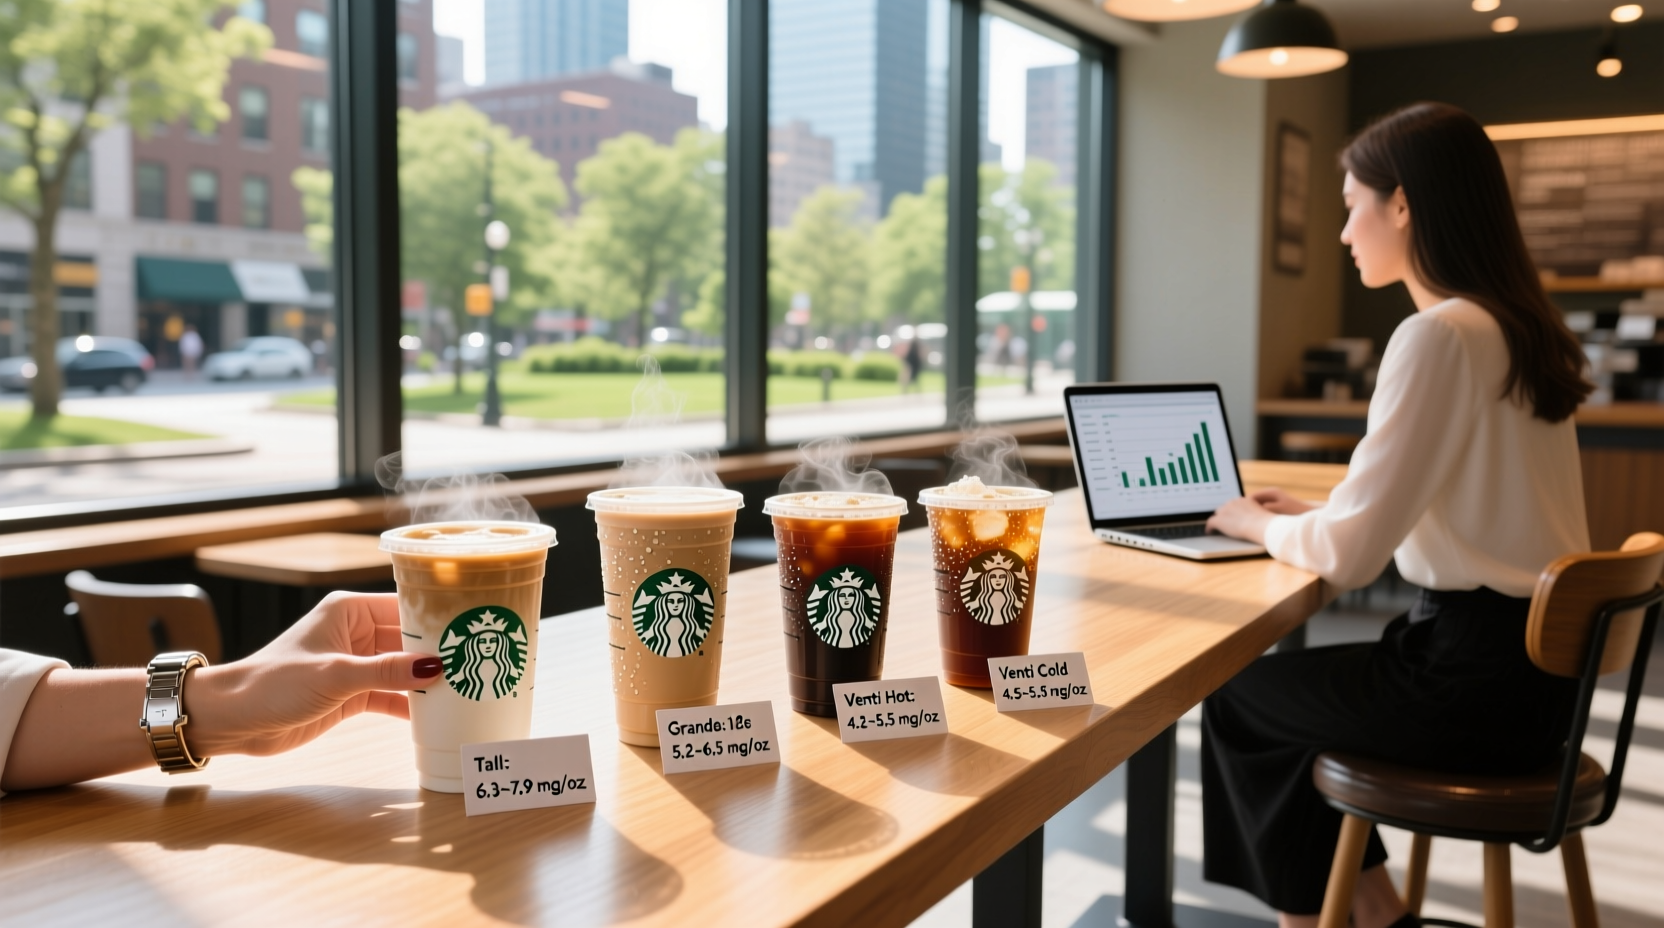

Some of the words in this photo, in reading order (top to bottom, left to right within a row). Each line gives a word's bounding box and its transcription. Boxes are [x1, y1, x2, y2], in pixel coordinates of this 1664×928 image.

[998, 664, 1034, 680] Venti
[1037, 661, 1069, 677] Cold
[844, 690, 881, 707] Venti
[885, 689, 915, 704] Hot:
[898, 708, 940, 728] mg/oz
[727, 737, 770, 757] mg/oz
[473, 754, 510, 773] Tall:
[537, 774, 587, 796] mg/oz
